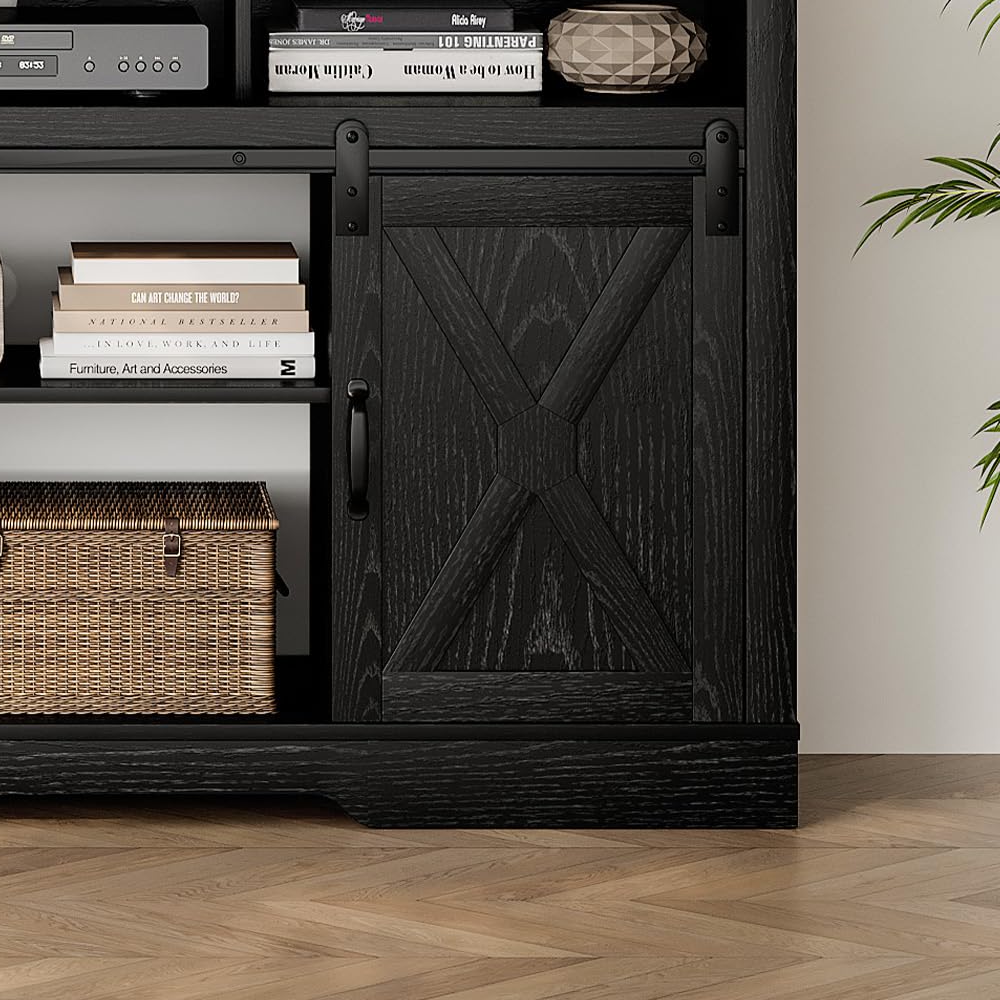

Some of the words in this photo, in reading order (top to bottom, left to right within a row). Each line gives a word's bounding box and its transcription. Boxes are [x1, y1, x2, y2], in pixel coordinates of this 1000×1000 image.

[292, 38, 316, 46] JAMES
[438, 35, 460, 48] 101
[464, 35, 537, 48] PARENTING
[274, 64, 320, 79] Moran
[323, 64, 373, 79] Caitlin
[403, 64, 456, 79] Woman
[458, 64, 466, 75] a
[469, 64, 485, 79] be
[488, 64, 501, 79] to
[505, 64, 535, 79] How
[131, 292, 147, 304] CAN
[149, 292, 162, 304] ART
[164, 292, 193, 304] CHANGE
[195, 292, 208, 304] THE
[209, 292, 239, 304] WORLD?
[88, 318, 167, 326] NATIONAL
[178, 318, 279, 326] BESTSELLER
[212, 340, 240, 349] AND
[249, 340, 282, 349] LIFE
[69, 363, 120, 376] Furniture,
[122, 363, 138, 374] Art
[140, 363, 161, 374] and
[163, 363, 228, 374] Accessories
